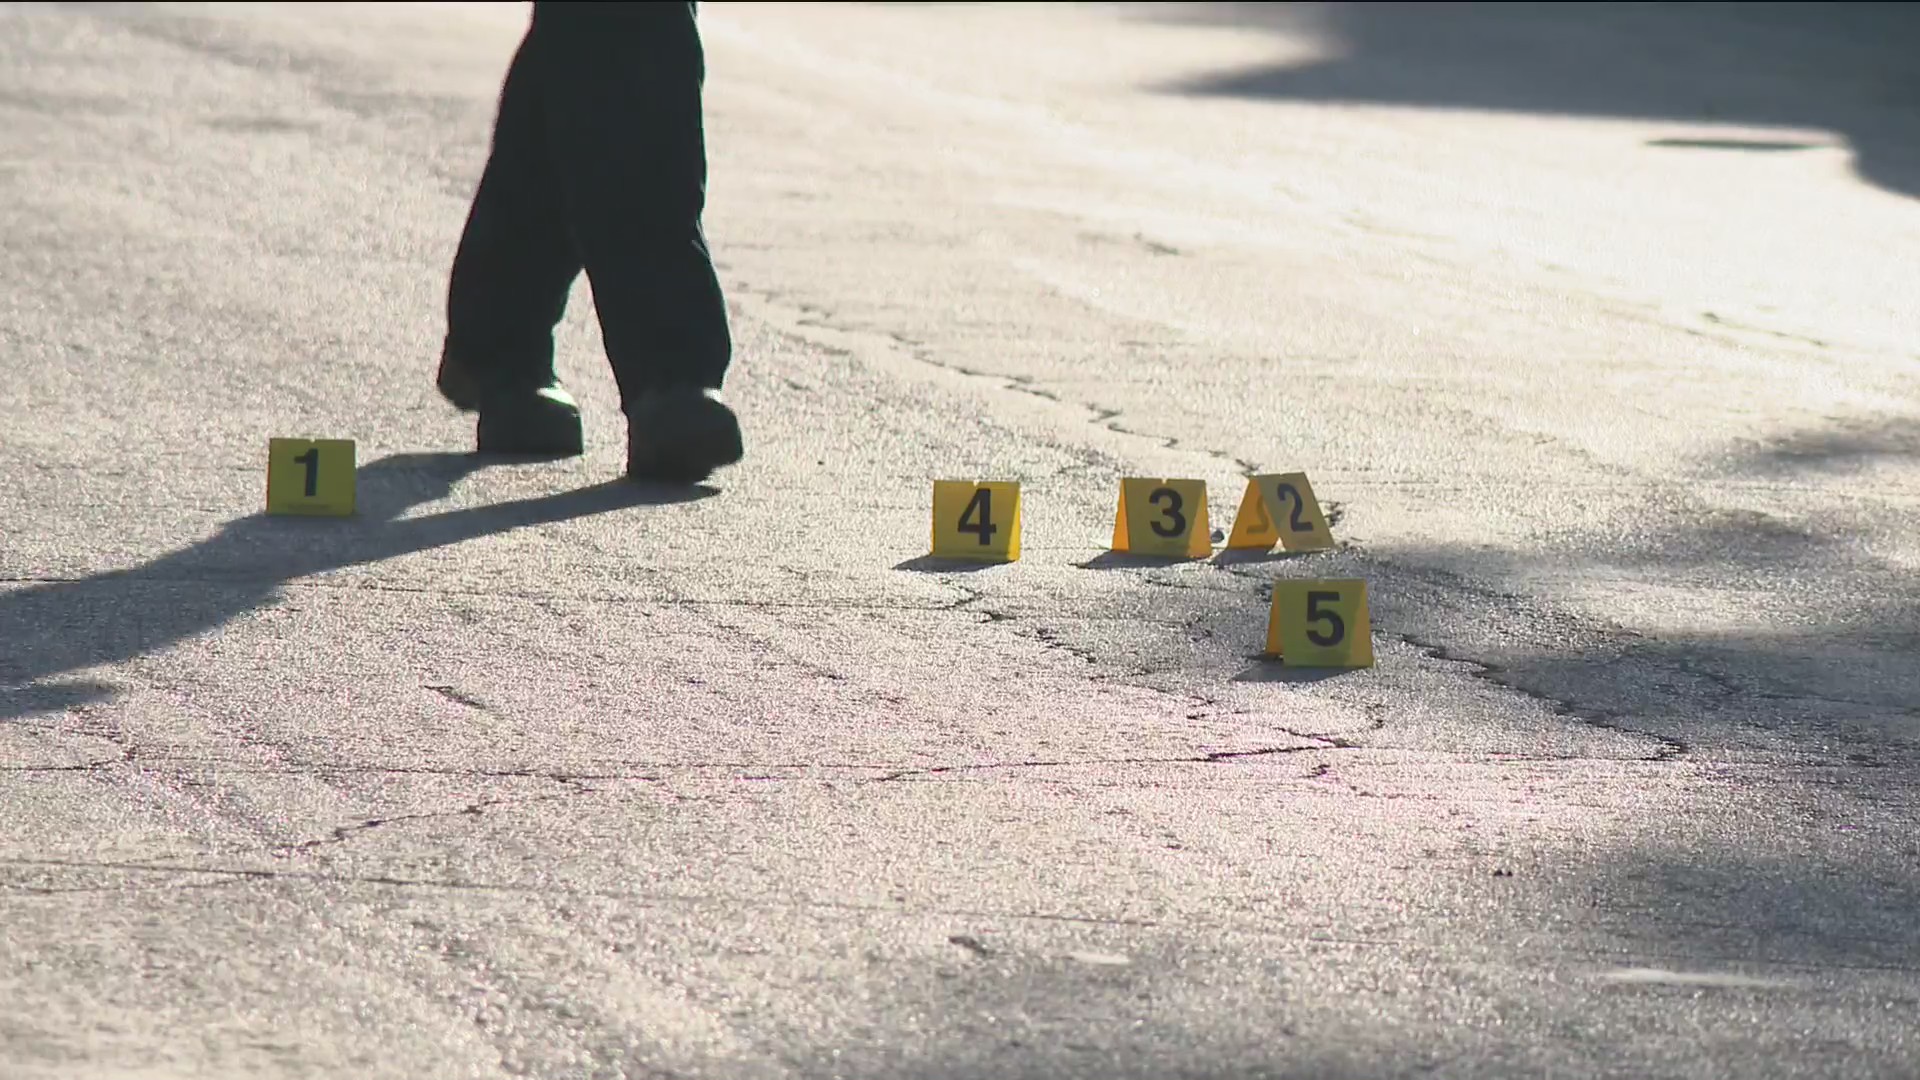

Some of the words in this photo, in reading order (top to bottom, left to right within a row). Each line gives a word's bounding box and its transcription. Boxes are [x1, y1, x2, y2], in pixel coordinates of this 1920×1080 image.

[294, 448, 318, 497] 1
[958, 488, 996, 545] 4
[1149, 487, 1186, 538] 3
[1277, 483, 1313, 532] 2
[1306, 591, 1344, 647] 5
